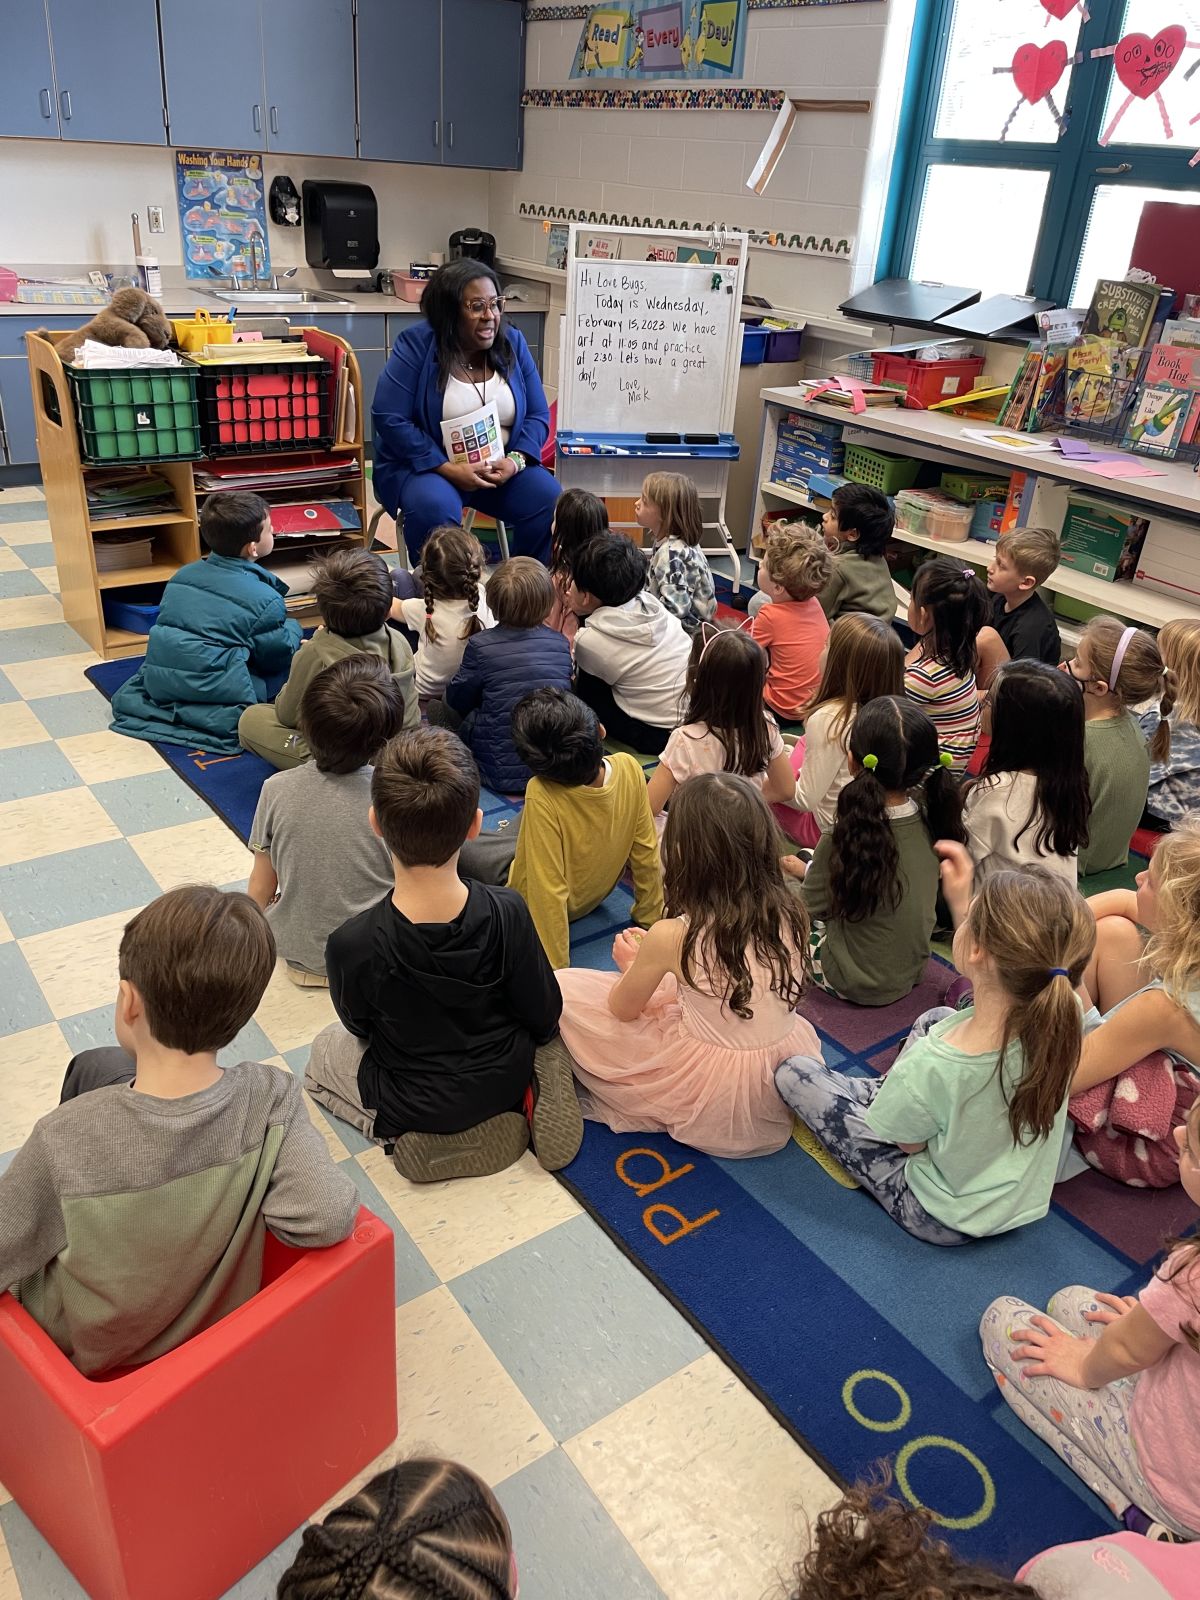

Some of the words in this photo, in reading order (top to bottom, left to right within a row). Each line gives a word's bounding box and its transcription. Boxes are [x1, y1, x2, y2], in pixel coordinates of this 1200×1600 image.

[591, 23, 620, 45] Read
[646, 26, 680, 48] Every
[706, 19, 735, 47] Day!
[178, 153, 208, 168] Washing
[209, 153, 226, 166] Your
[581, 268, 592, 287] Hi
[597, 271, 617, 288] Love
[621, 275, 647, 295] Bugs,
[593, 293, 623, 314] Today
[629, 299, 639, 309] is
[645, 295, 709, 316] Wednesday,
[1100, 282, 1152, 309] SUBSTITUTE
[578, 313, 623, 333] February
[672, 321, 687, 334] We
[694, 321, 717, 336] have
[577, 331, 594, 347] art
[601, 332, 613, 348] at
[641, 337, 659, 351] and
[663, 340, 703, 356] practice
[576, 350, 585, 366] at
[644, 353, 662, 366] have
[670, 358, 676, 367] a
[682, 355, 708, 374] great
[1157, 356, 1181, 370] Book
[1168, 368, 1190, 384] Hog
[1146, 391, 1163, 401] Things
[1144, 406, 1156, 414] Like
